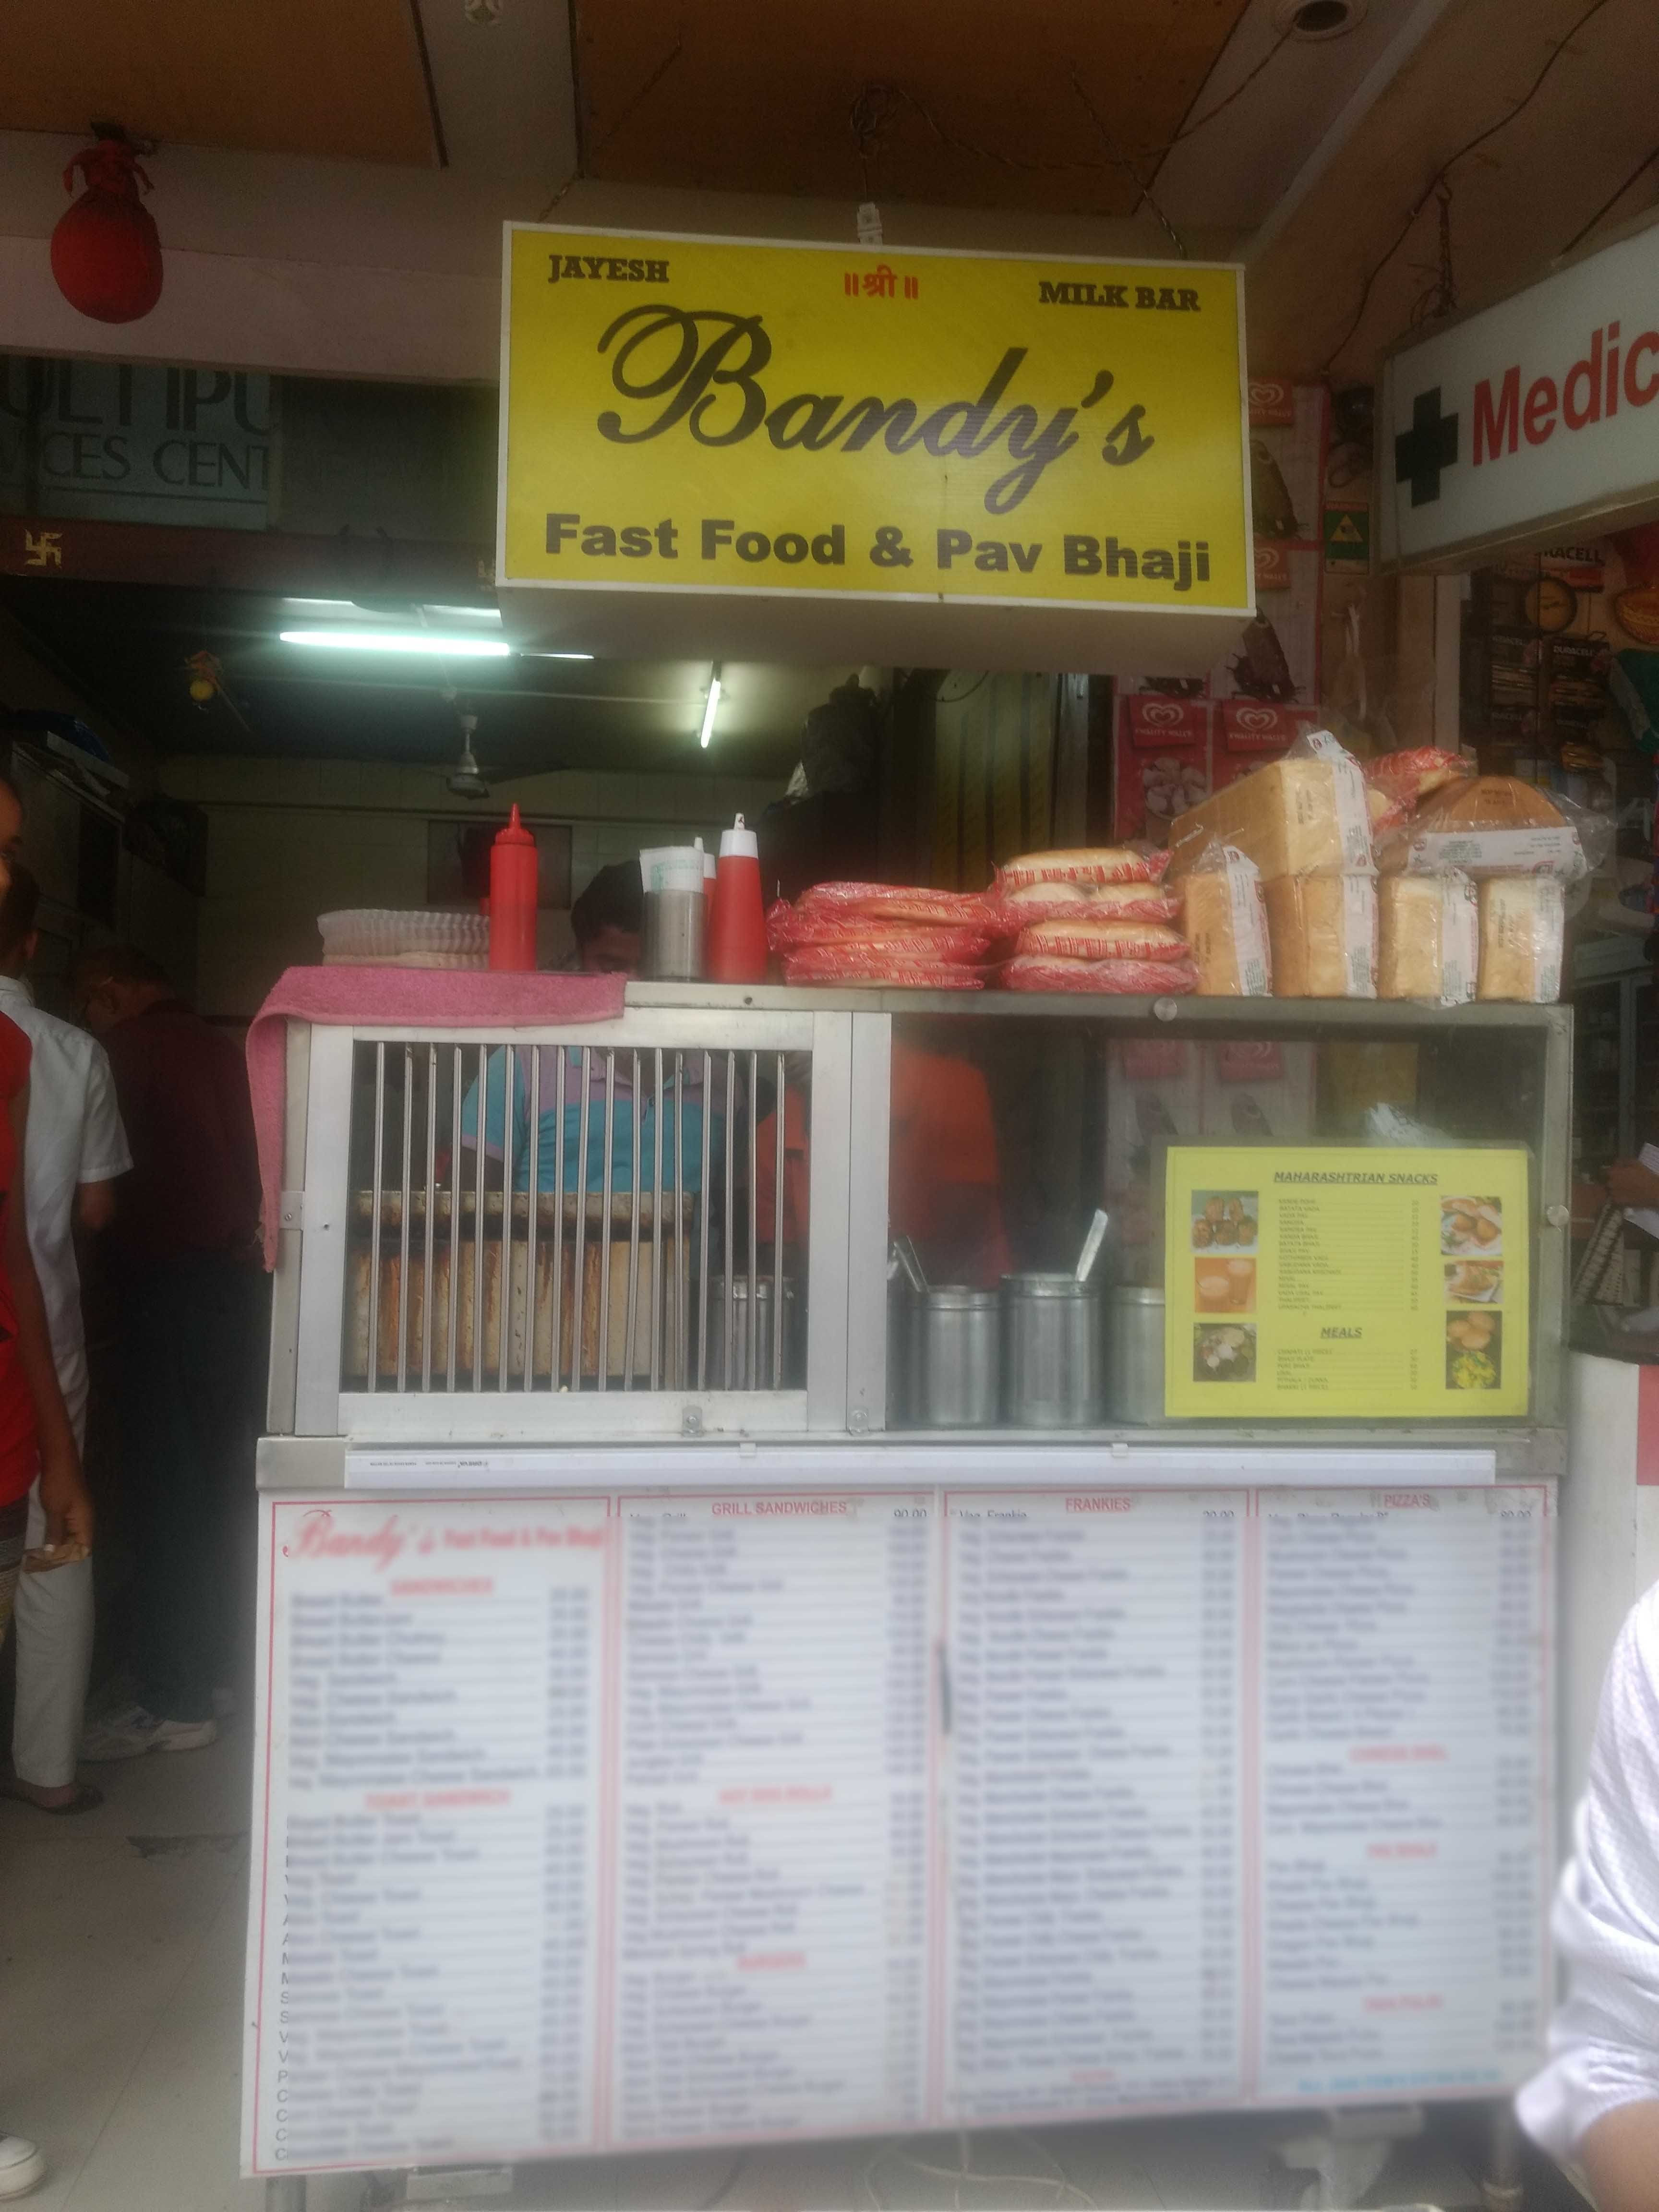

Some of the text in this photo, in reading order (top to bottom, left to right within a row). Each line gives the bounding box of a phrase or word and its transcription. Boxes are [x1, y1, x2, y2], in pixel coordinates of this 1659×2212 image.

[548, 254, 670, 283] JAYESH
[1039, 281, 1201, 312] MILK BAR
[597, 304, 1155, 515] Bandy's
[546, 513, 1210, 591] Fast Food & Pav Bhaji
[1274, 1171, 1438, 1185] MAHARASHTRIAN SNACKS
[1321, 1326, 1362, 1339] MEALS
[711, 1501, 847, 1516] GRILL SANDWICHES
[1065, 1497, 1131, 1513] FRANKIES
[1383, 1493, 1431, 1508] PIZZA'S
